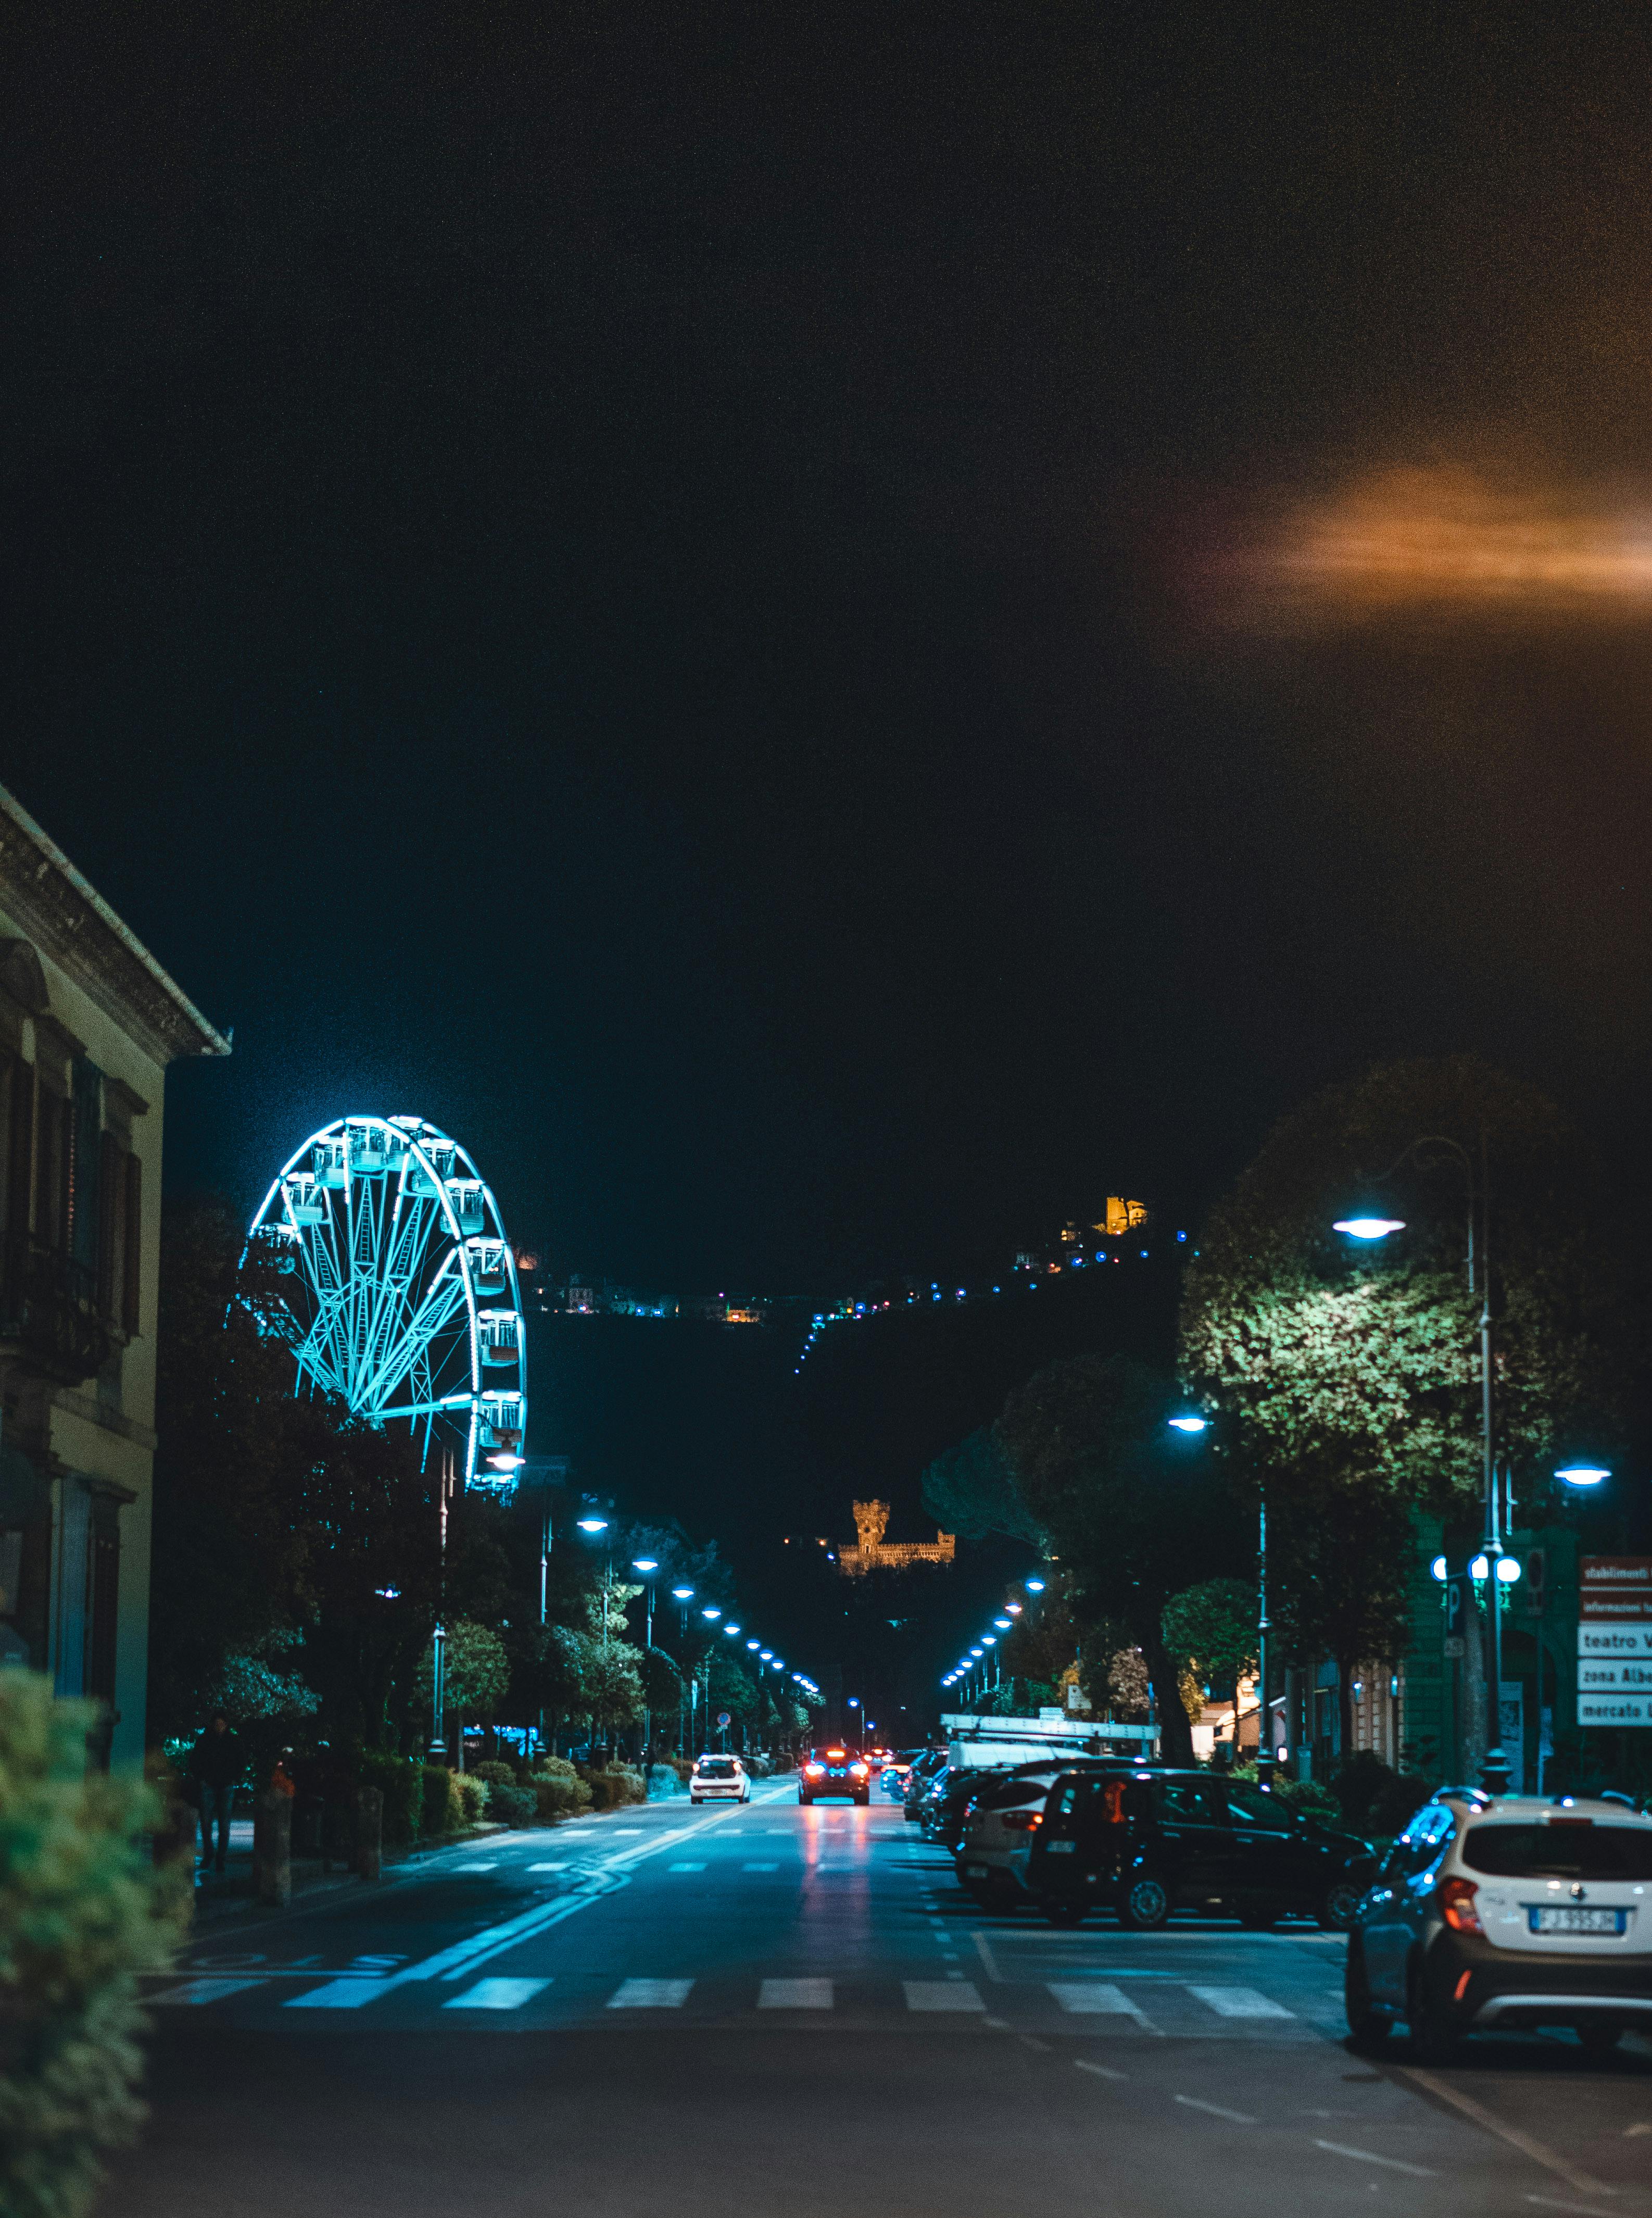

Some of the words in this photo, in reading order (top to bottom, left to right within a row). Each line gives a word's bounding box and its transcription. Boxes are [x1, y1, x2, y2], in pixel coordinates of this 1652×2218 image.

[1584, 1635, 1637, 1648] teatro
[1584, 1672, 1615, 1682] zona
[1583, 1705, 1640, 1718] mercato
